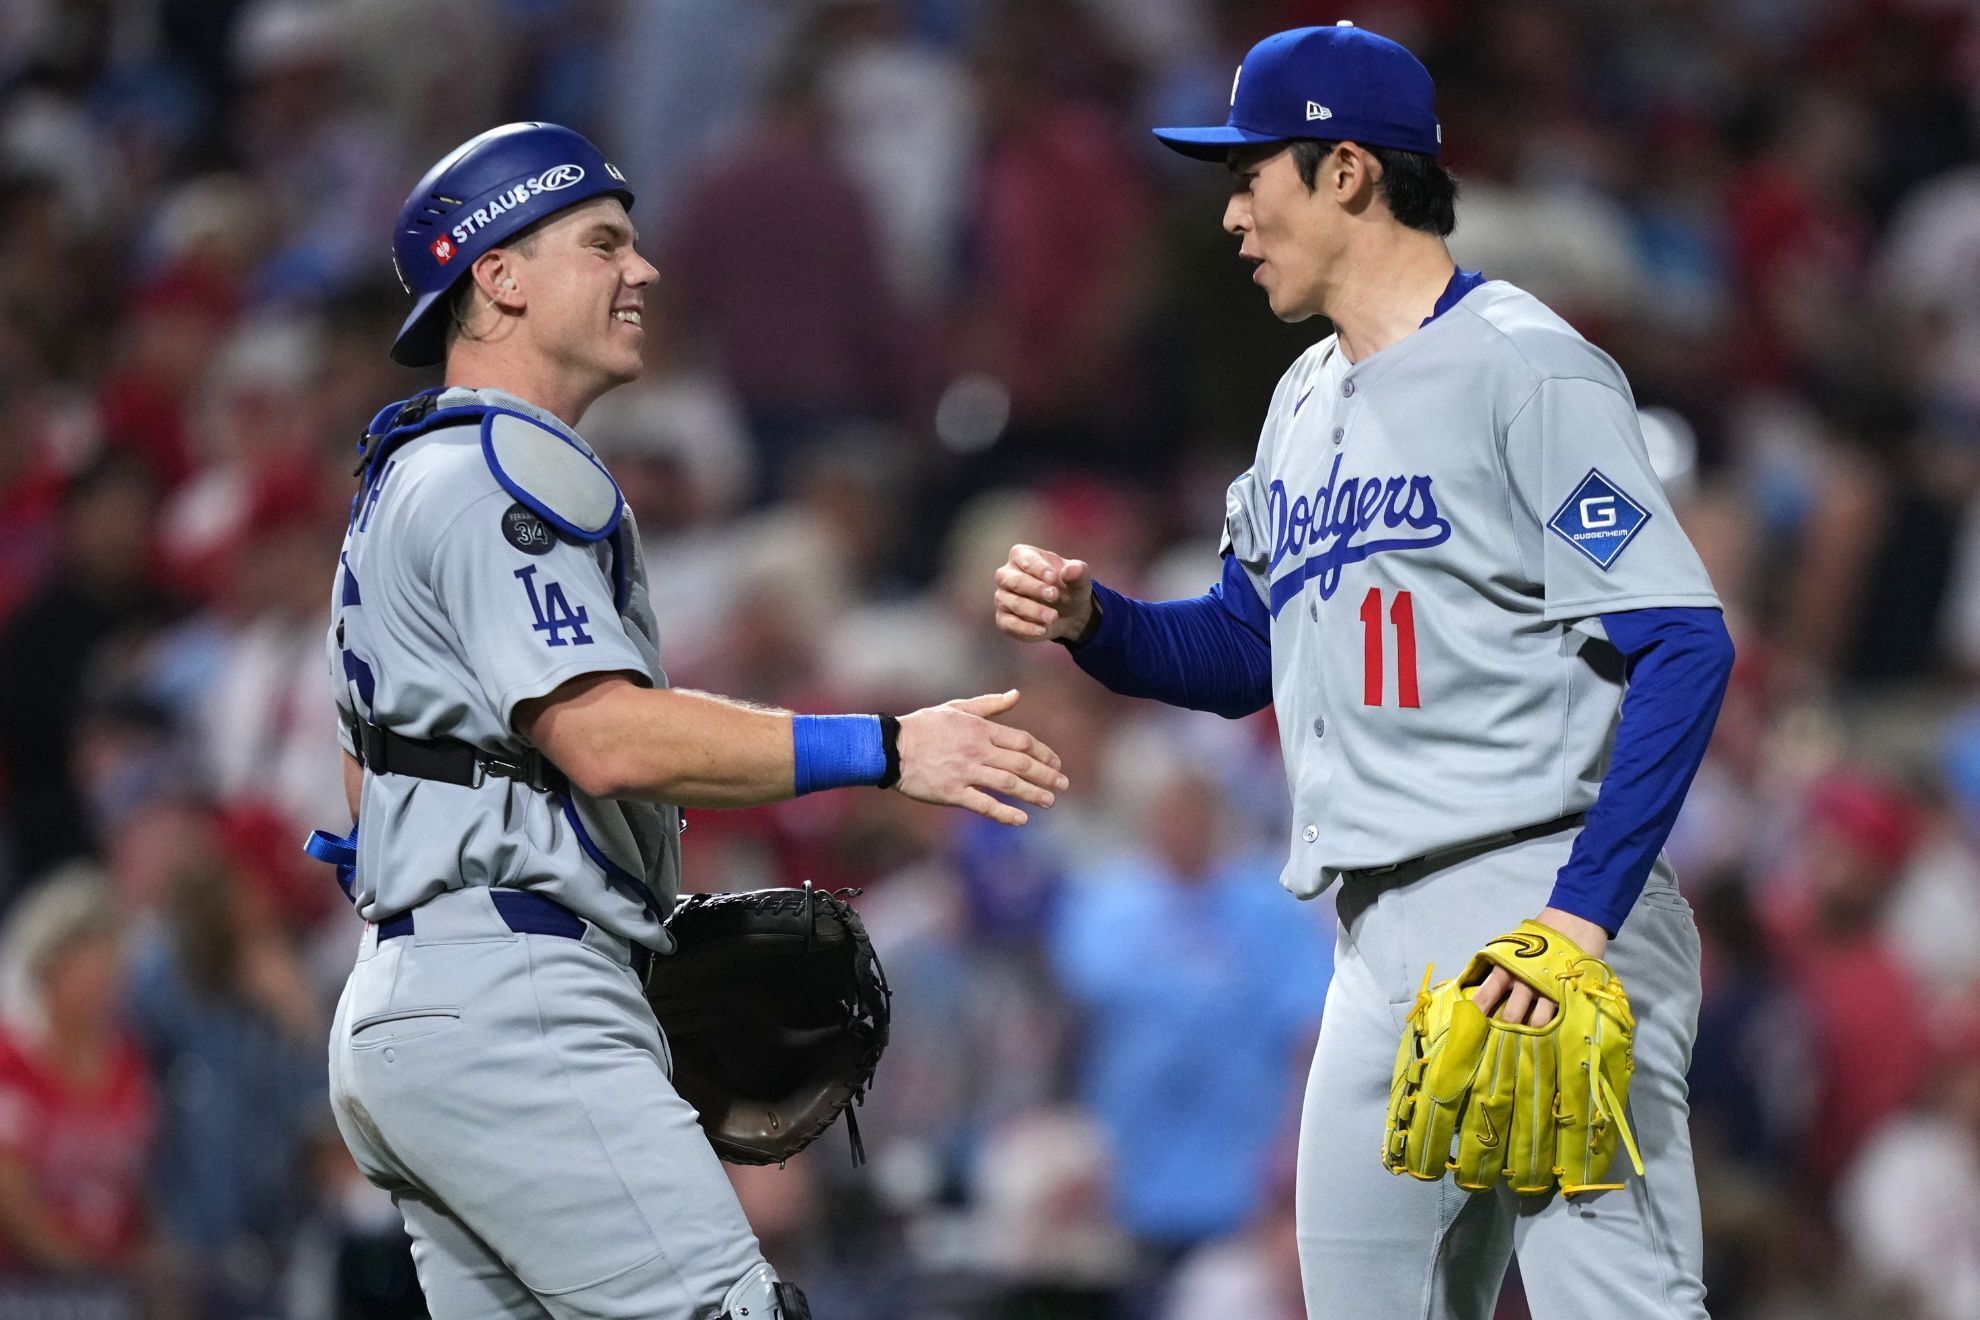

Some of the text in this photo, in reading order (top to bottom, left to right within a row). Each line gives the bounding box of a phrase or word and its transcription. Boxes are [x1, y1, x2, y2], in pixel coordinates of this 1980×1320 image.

[452, 178, 543, 243] STRAUSS
[514, 521, 548, 546] 34
[1269, 453, 1451, 602] Dodgers
[1573, 529, 1628, 541] GUGGENHEIM
[1579, 495, 1617, 529] G
[514, 563, 594, 647] LA
[1360, 587, 1420, 709] 11
